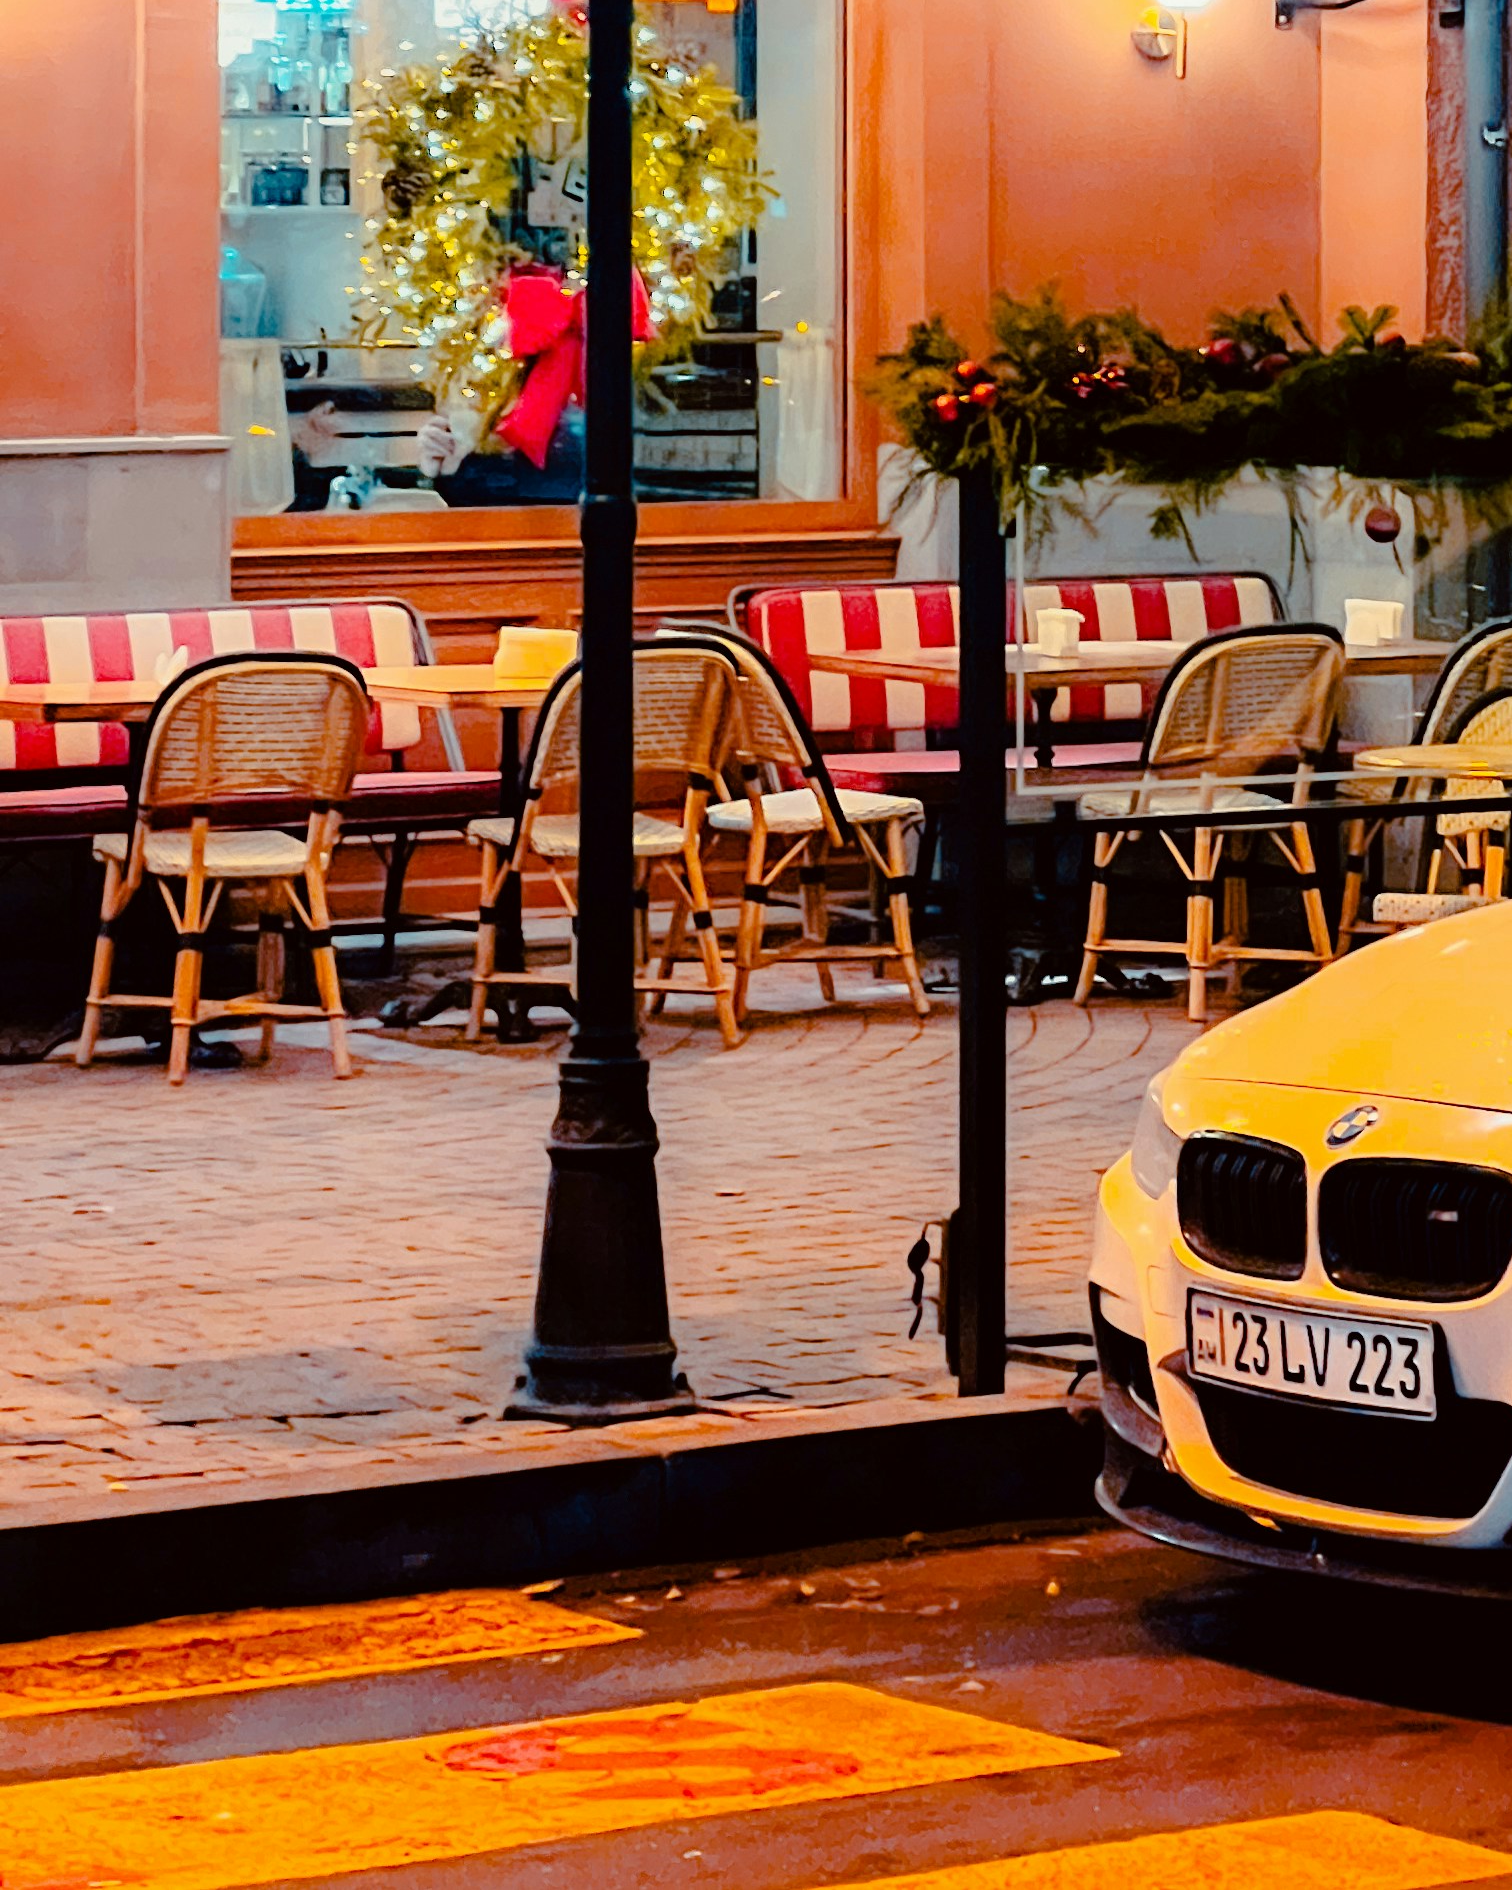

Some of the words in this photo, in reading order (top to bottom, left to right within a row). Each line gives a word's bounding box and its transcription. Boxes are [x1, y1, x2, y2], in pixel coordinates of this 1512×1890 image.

[1232, 1311, 1270, 1376] 23
[1279, 1320, 1330, 1387] LV
[1346, 1331, 1421, 1400] 223
